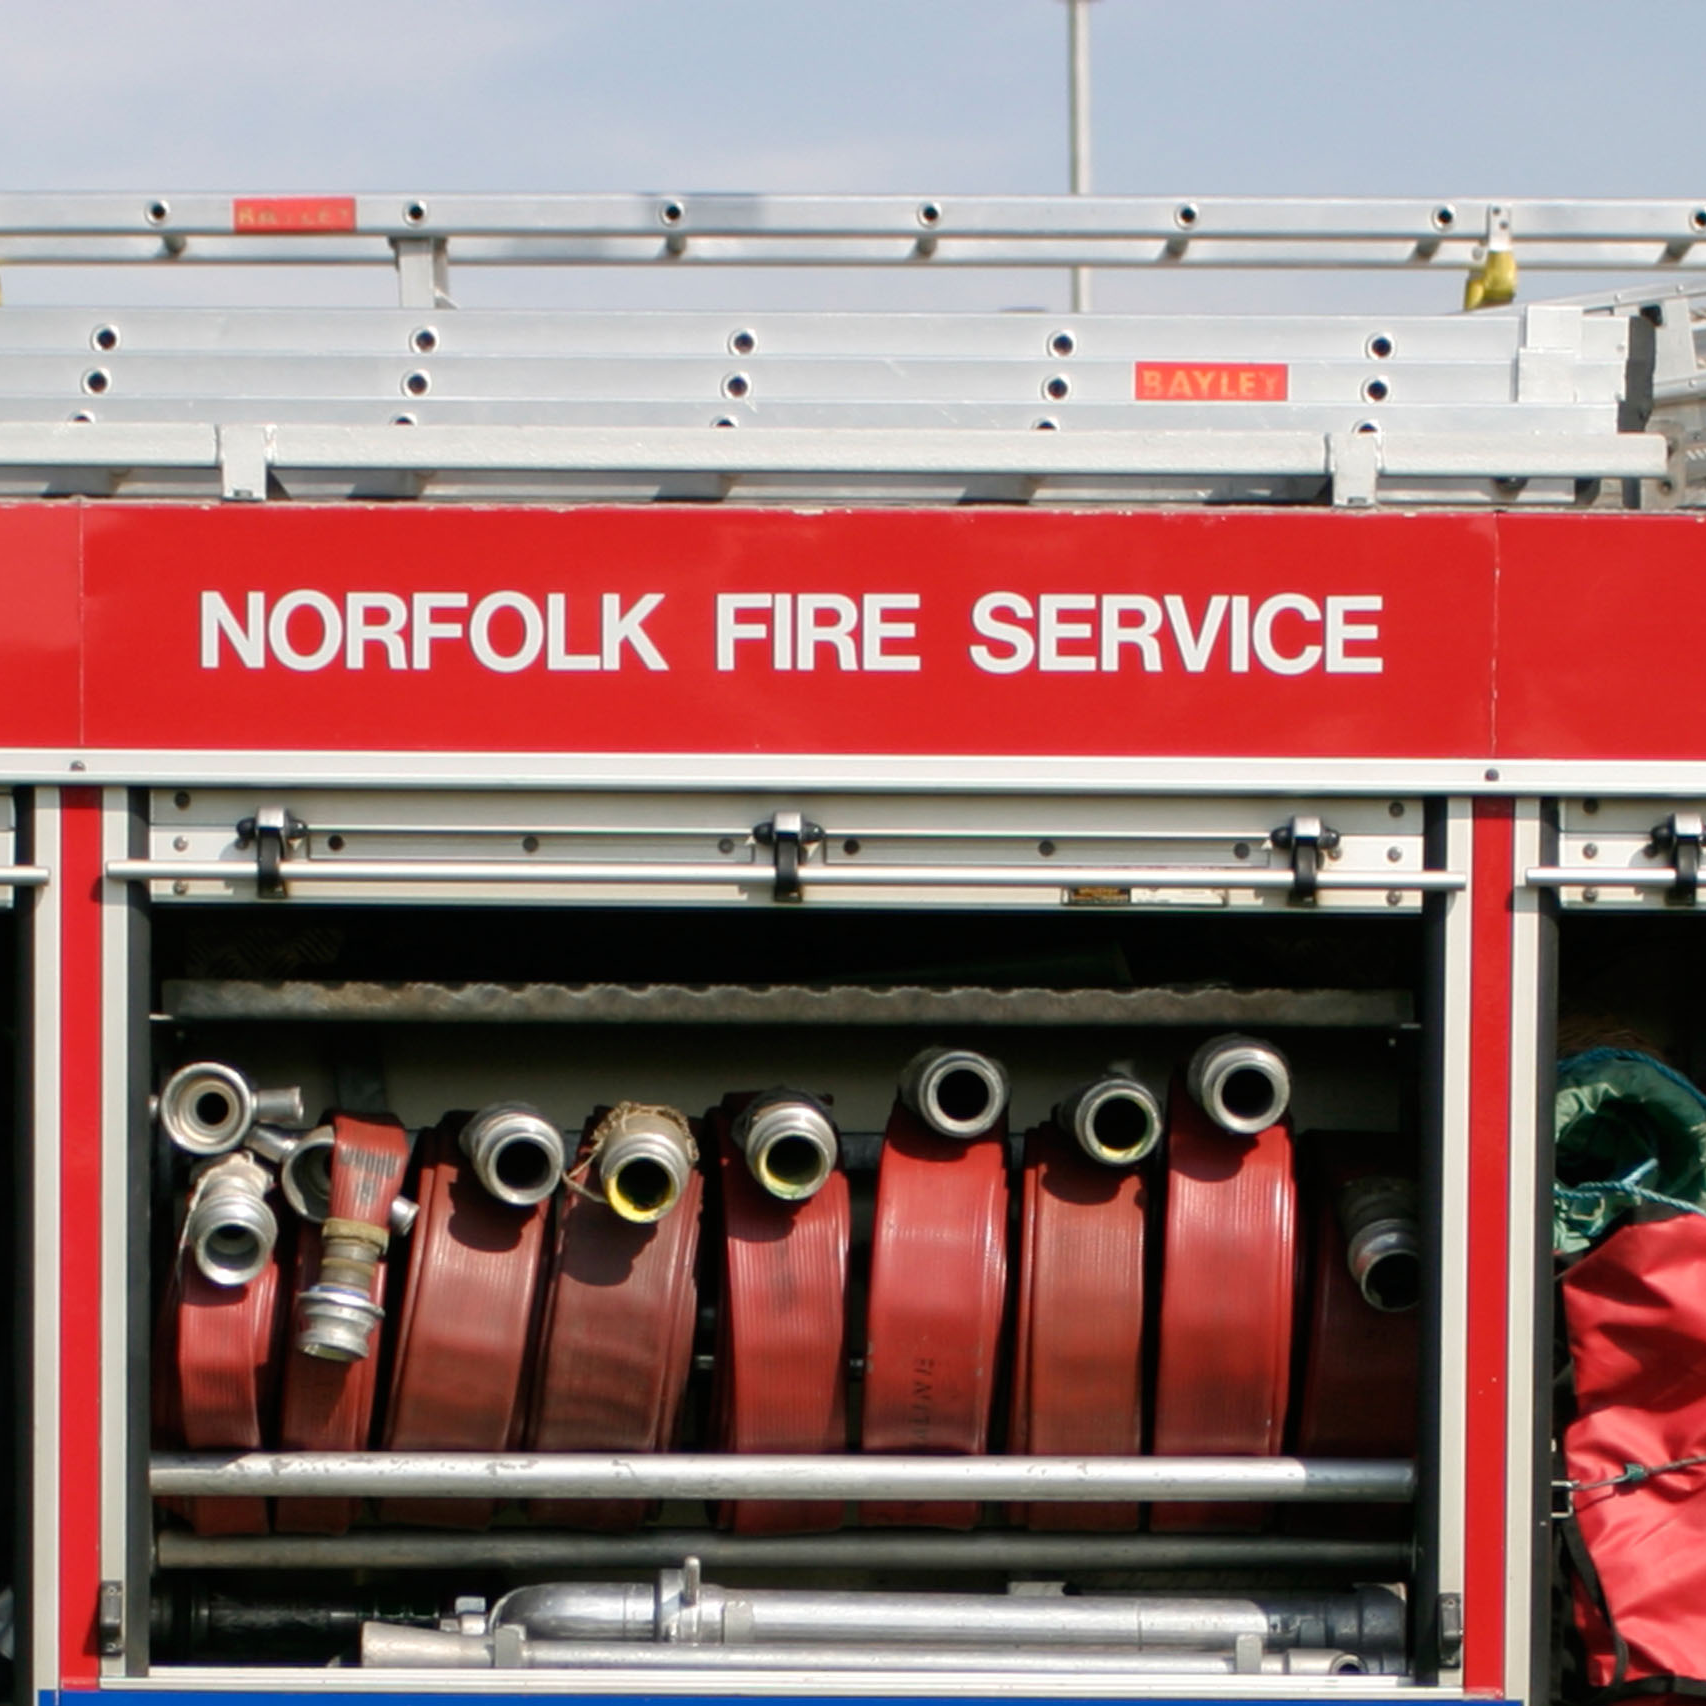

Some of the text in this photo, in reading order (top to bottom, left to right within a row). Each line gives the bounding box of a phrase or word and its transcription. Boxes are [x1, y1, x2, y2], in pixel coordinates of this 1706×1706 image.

[1142, 369, 1279, 397] BAYLEY
[199, 590, 1385, 676] NORFOLK FIRE SERVICE
